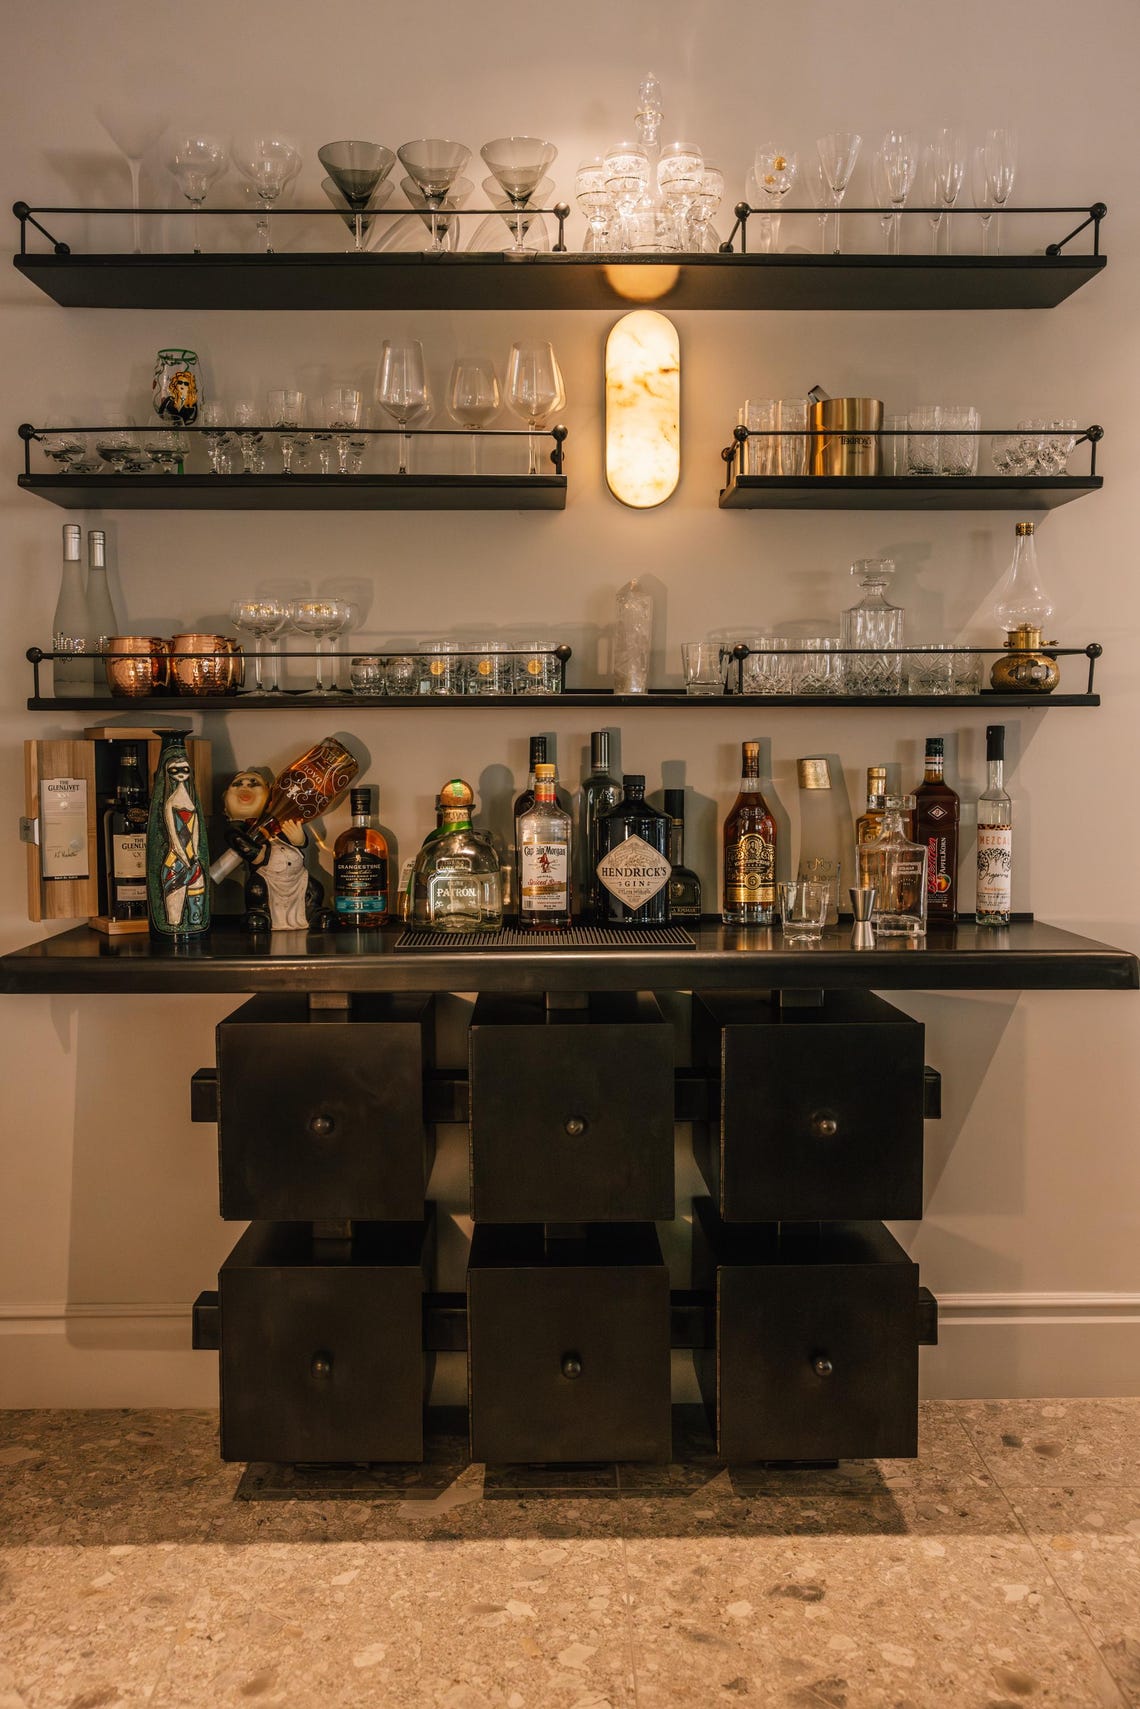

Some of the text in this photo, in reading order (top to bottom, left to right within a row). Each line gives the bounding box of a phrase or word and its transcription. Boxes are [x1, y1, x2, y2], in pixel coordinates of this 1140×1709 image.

[47, 784, 80, 792] GLENLIVET
[523, 845, 566, 857] Capain Morgan
[601, 866, 667, 878] HENDRICK'S
